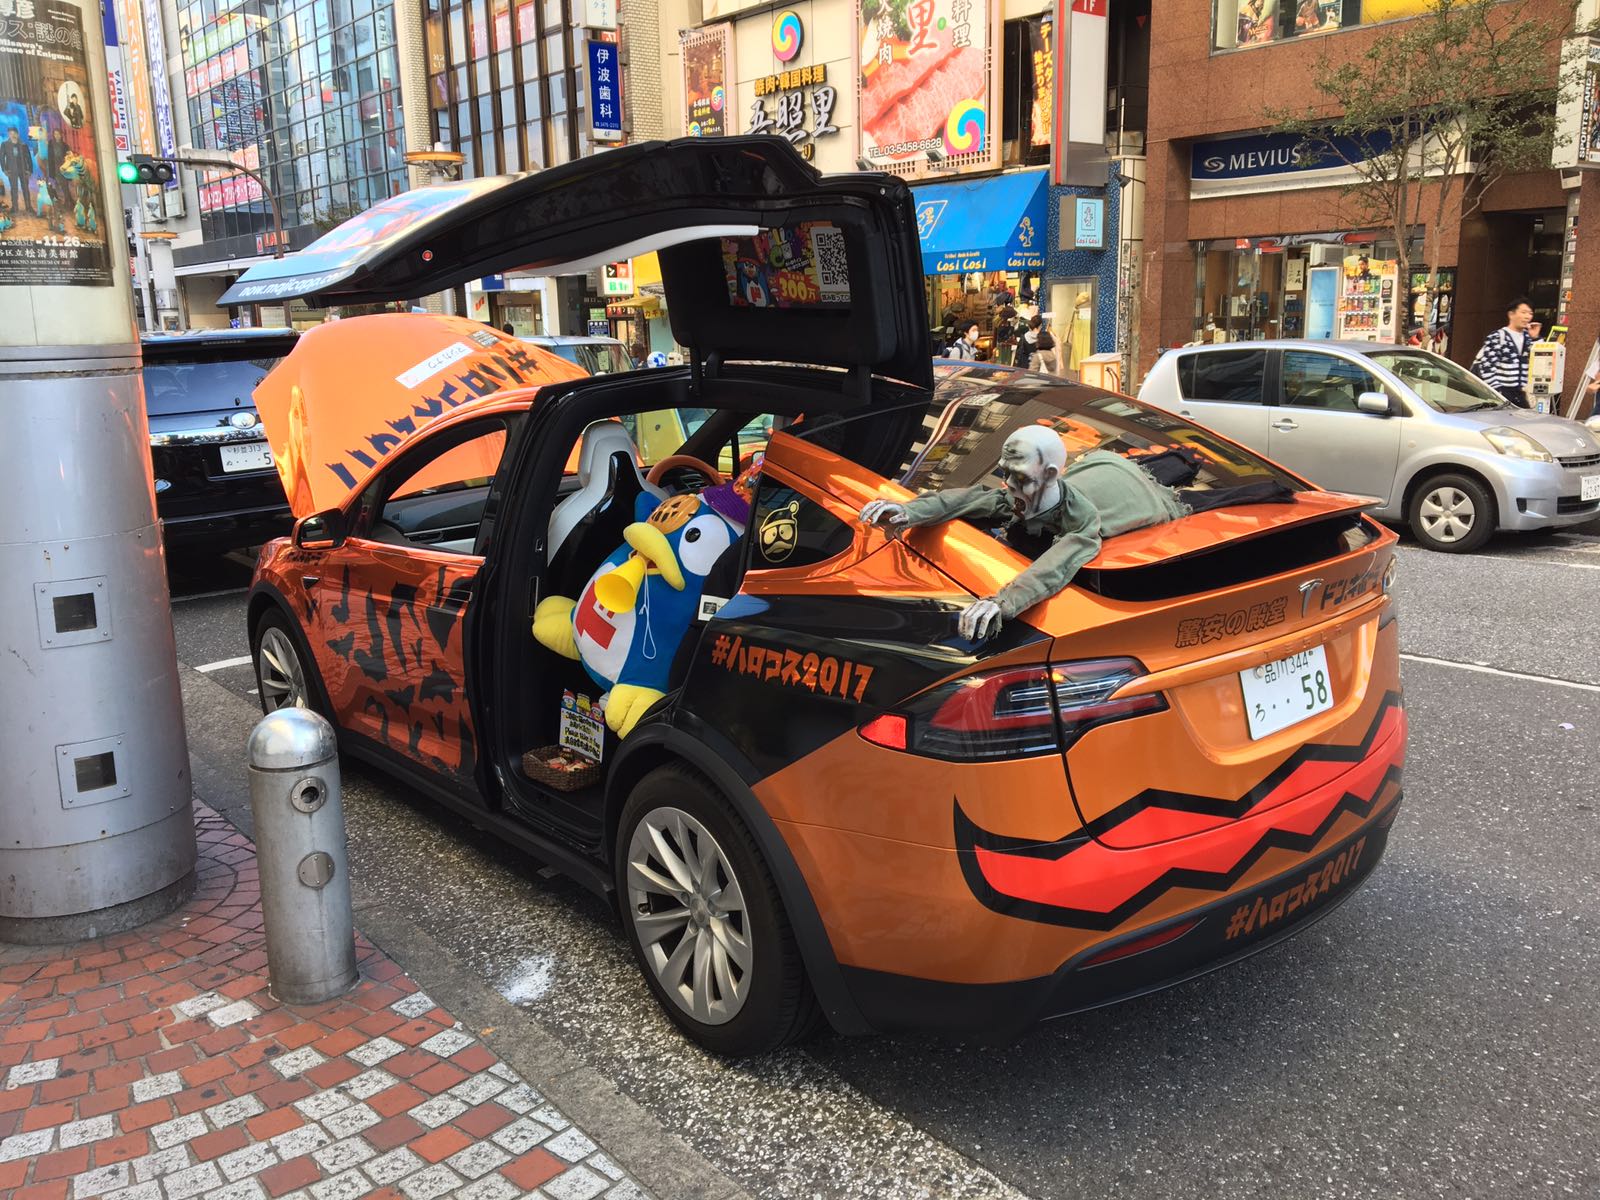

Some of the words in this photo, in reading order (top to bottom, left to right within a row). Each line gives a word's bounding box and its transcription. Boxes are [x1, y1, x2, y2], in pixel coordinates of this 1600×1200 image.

[0, 46, 24, 54] ouse
[114, 70, 127, 129] SHIBUYA
[596, 48, 613, 119] 伊波歯科
[1582, 70, 1593, 110] CARDS
[1578, 112, 1589, 159] SPORTS
[1229, 145, 1301, 171] MEVIUS
[936, 259, 960, 272] Cosi
[963, 257, 987, 270] Cosi
[1007, 257, 1025, 267] Cosi
[1027, 257, 1045, 267] Cosi
[1175, 595, 1288, 648] 驚安の殿堂
[711, 634, 874, 704] #ハロコス2017
[1301, 670, 1328, 710] 58
[1225, 836, 1367, 940] #ハロコス2017
